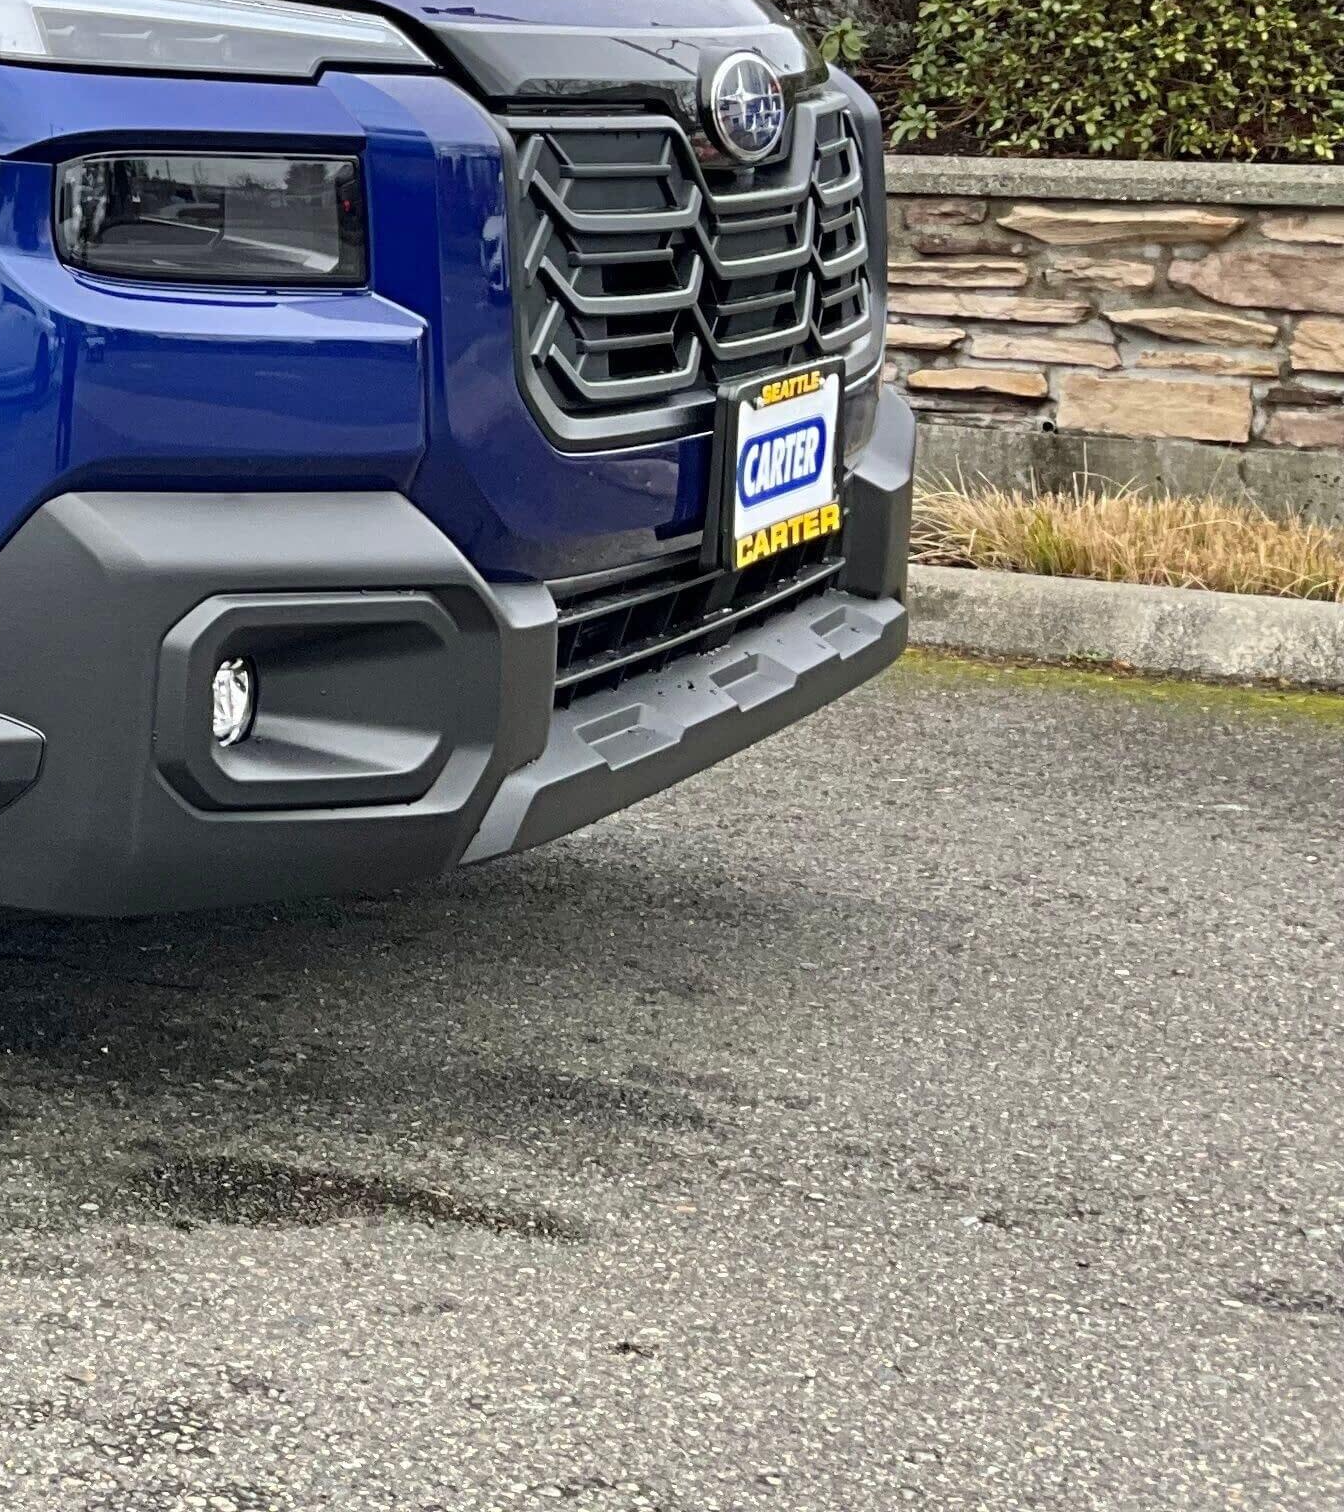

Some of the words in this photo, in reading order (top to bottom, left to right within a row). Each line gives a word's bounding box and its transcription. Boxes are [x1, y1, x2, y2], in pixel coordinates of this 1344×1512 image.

[762, 371, 821, 405] SEATTLE
[743, 426, 820, 498] CARTER
[736, 503, 840, 569] CARTER
